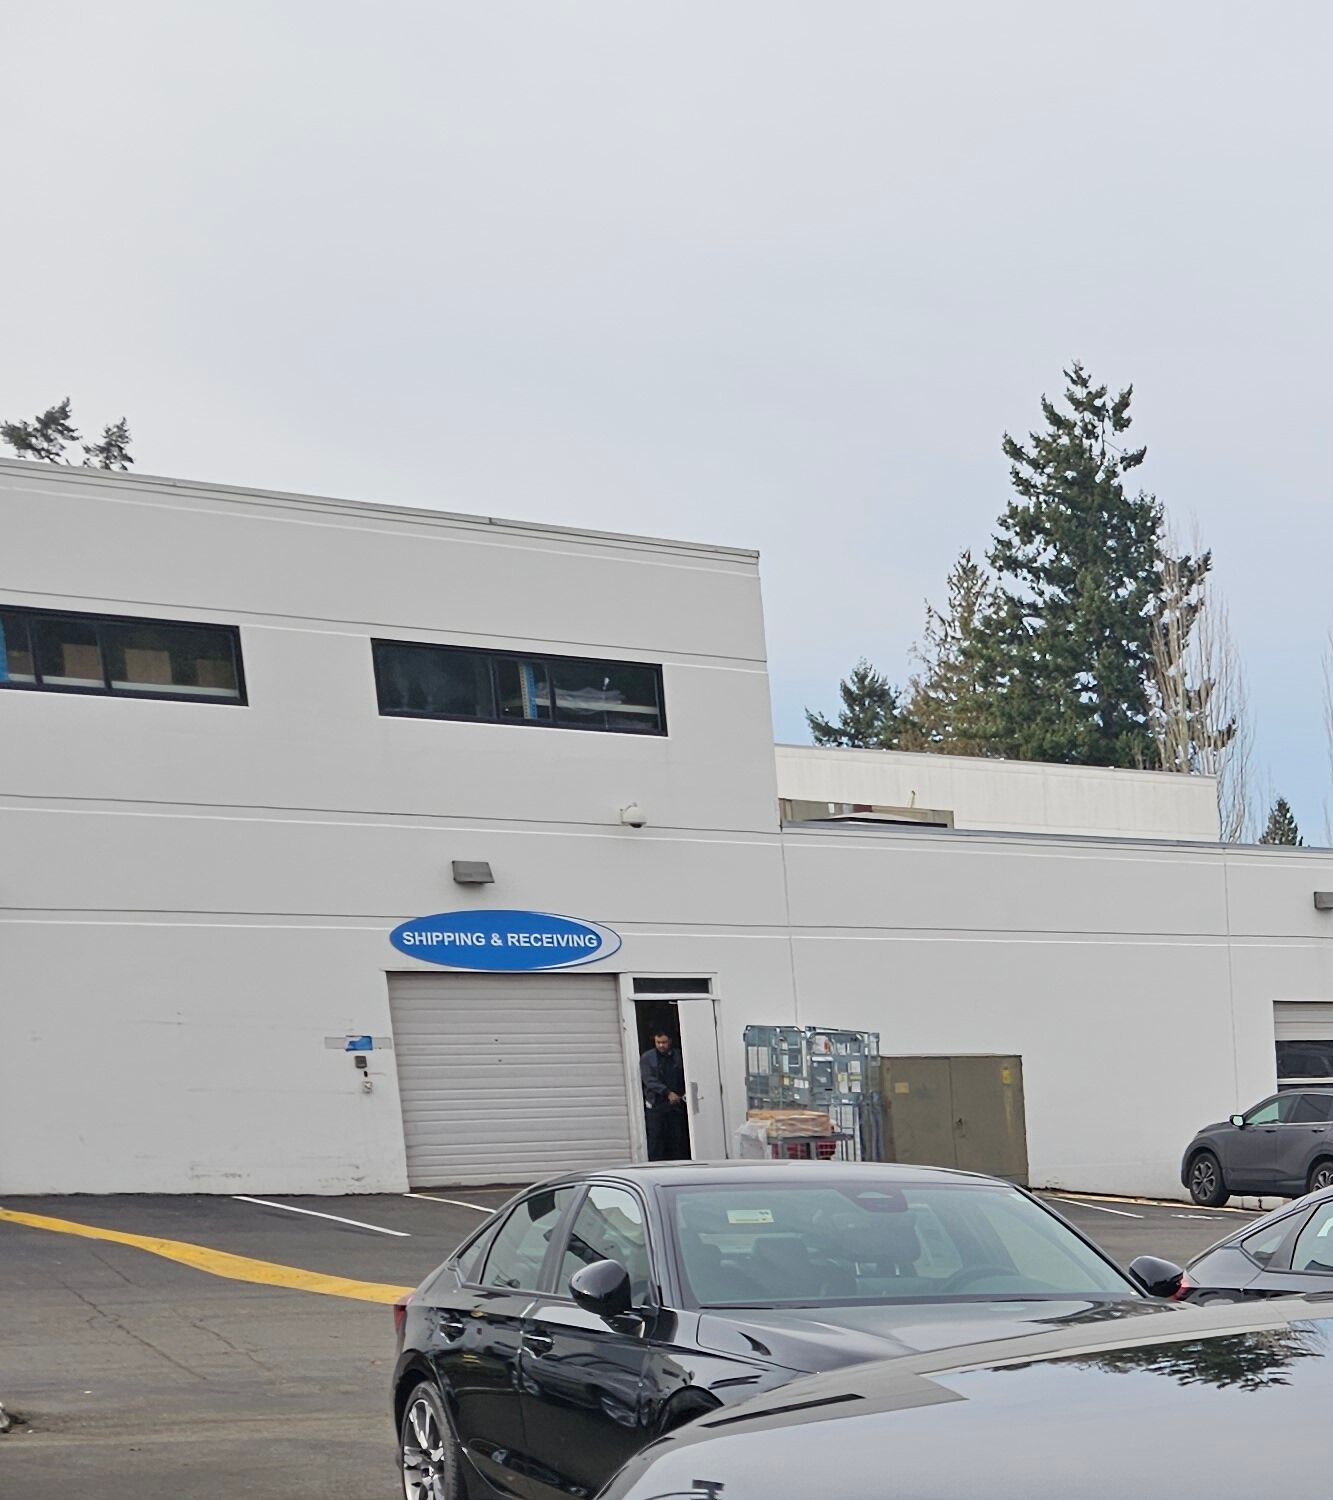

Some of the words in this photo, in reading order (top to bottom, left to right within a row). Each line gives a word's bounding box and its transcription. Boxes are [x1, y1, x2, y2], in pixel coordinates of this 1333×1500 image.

[402, 932, 485, 946] SHIPPING
[490, 933, 503, 946] &
[507, 933, 598, 948] RECEIVING
